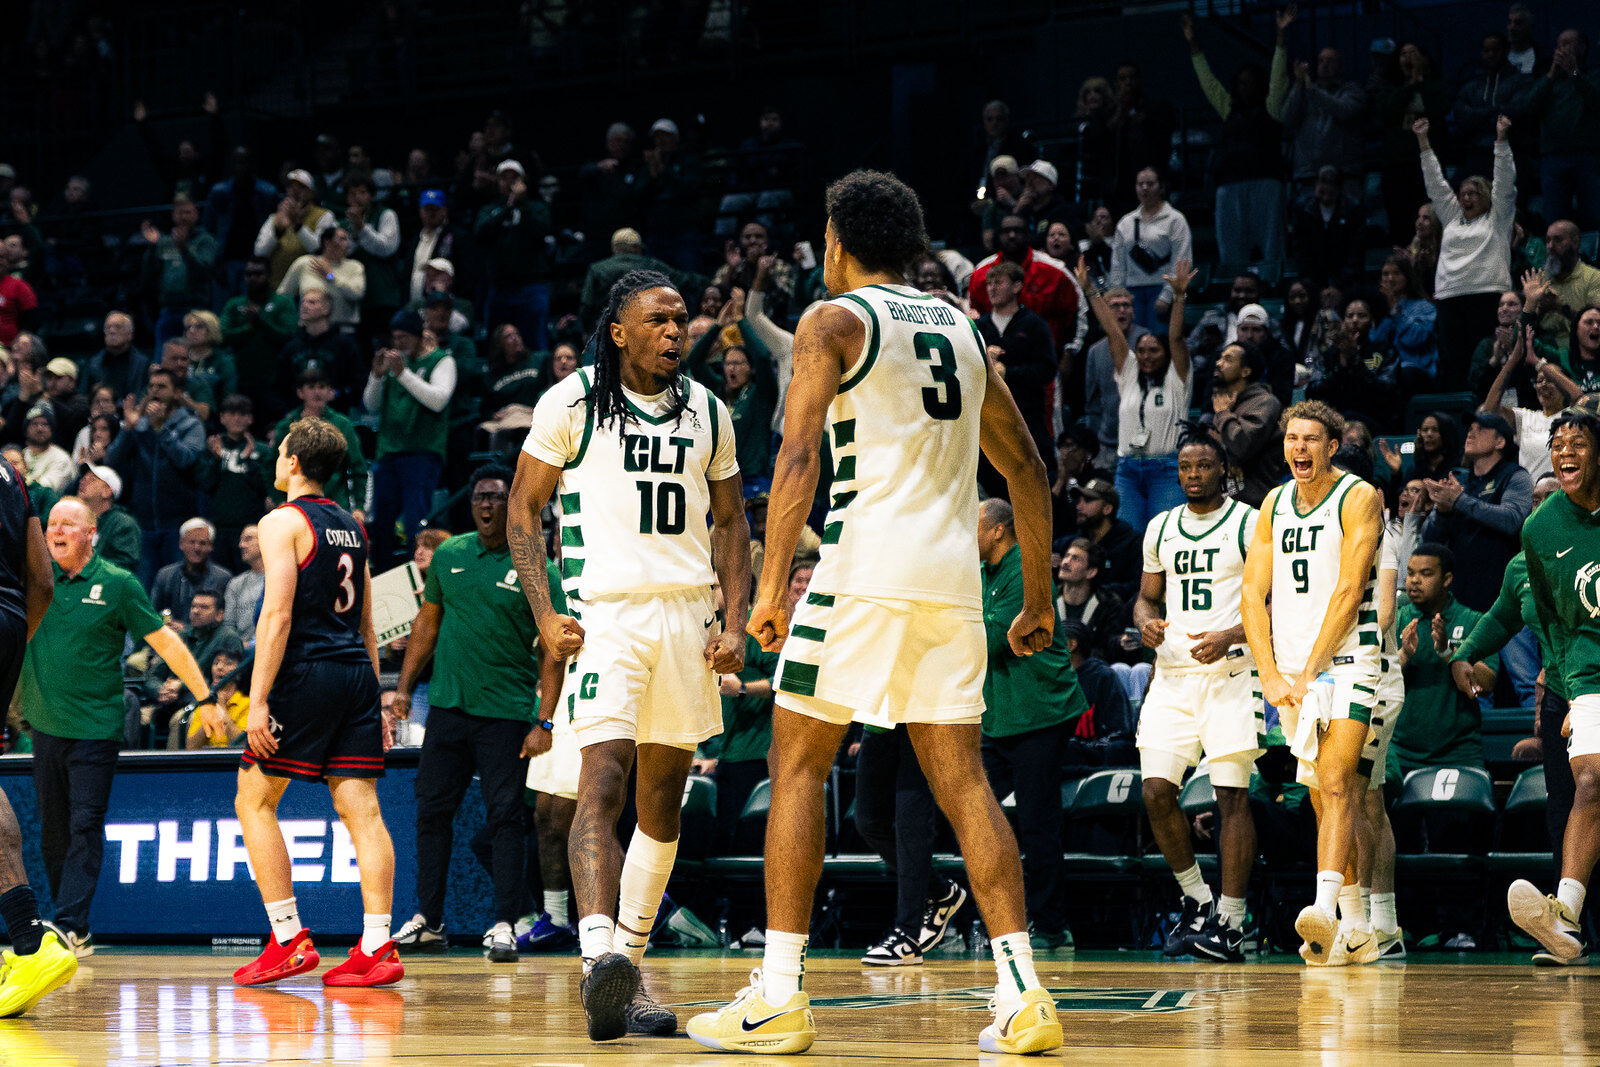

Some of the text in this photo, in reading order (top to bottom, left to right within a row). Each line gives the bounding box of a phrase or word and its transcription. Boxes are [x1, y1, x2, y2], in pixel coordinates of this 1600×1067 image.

[884, 300, 956, 326] BRADFORD
[913, 331, 962, 420] 3
[624, 434, 694, 474] CLT
[636, 480, 686, 534] 10
[325, 528, 360, 548] COVAL
[1282, 525, 1325, 554] CLT
[1174, 548, 1220, 575] CLT
[1292, 559, 1309, 593] 9
[334, 552, 356, 613] 3
[1181, 578, 1213, 611] 15
